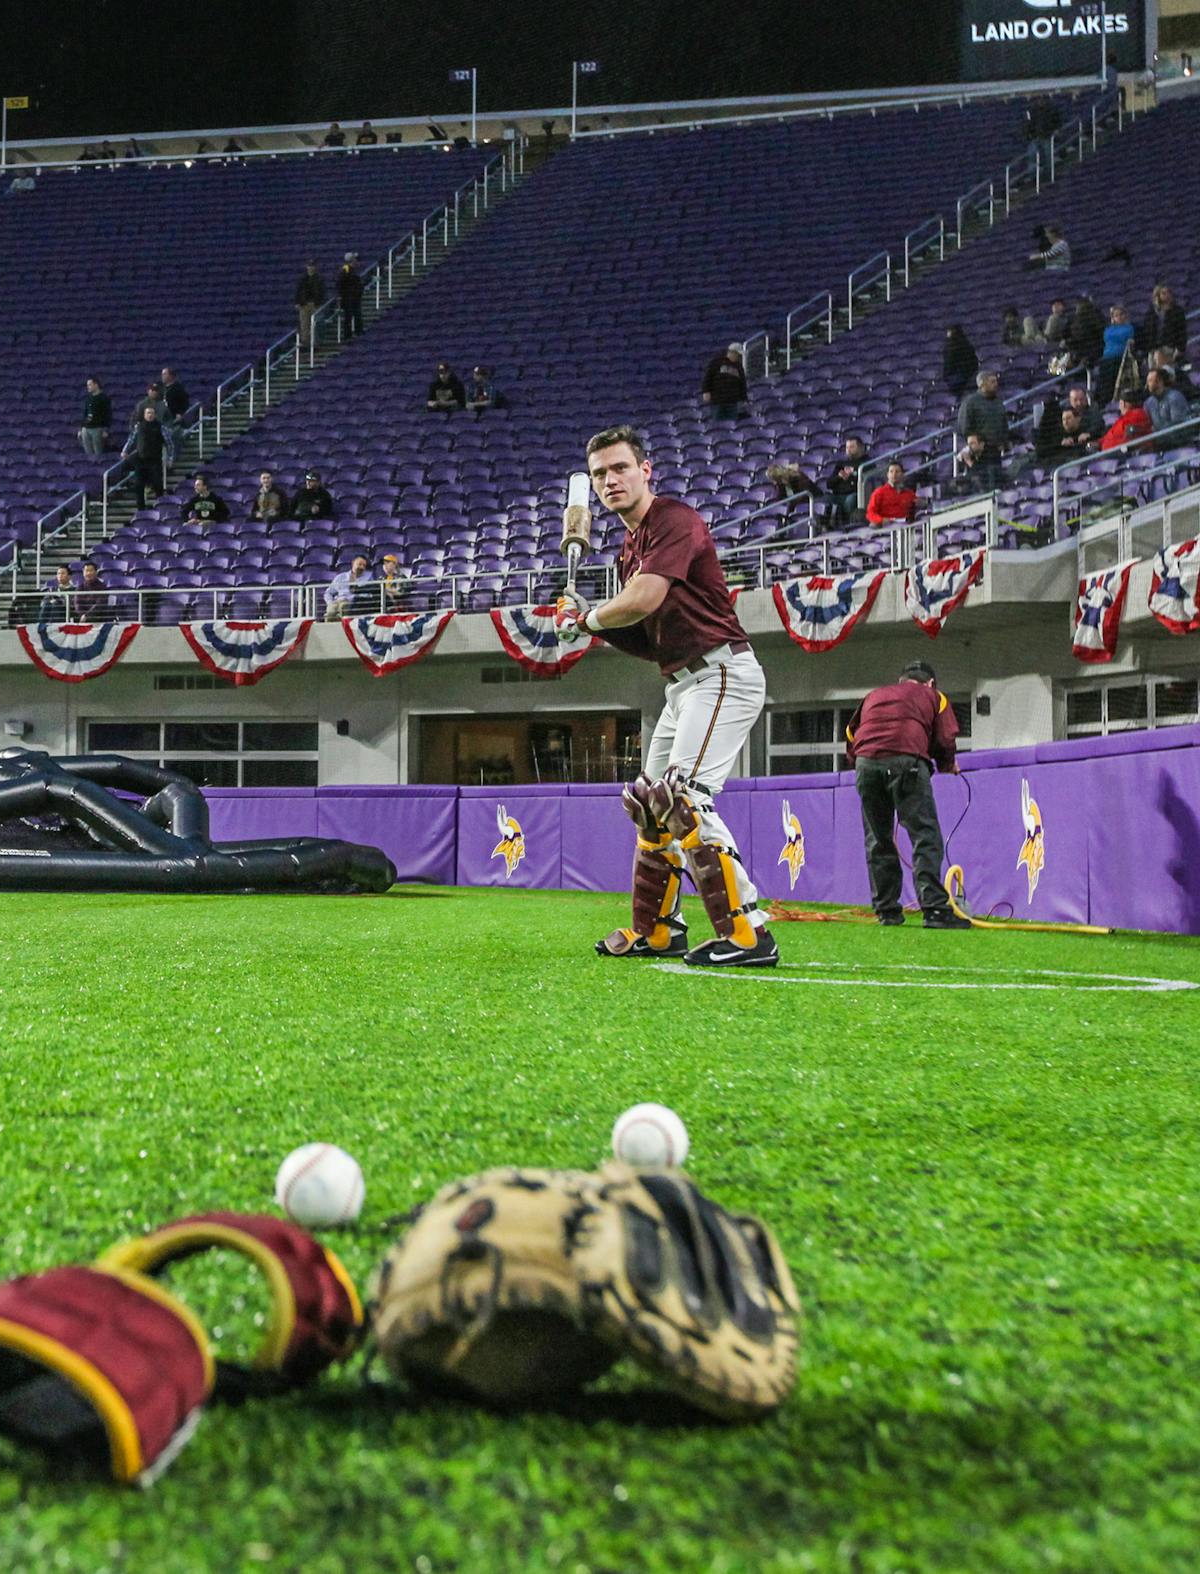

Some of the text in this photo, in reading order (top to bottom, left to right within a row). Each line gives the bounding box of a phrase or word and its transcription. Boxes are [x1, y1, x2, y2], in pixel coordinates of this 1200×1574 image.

[971, 19, 1029, 42] LAND
[580, 61, 597, 73] 122
[454, 69, 470, 81] 121
